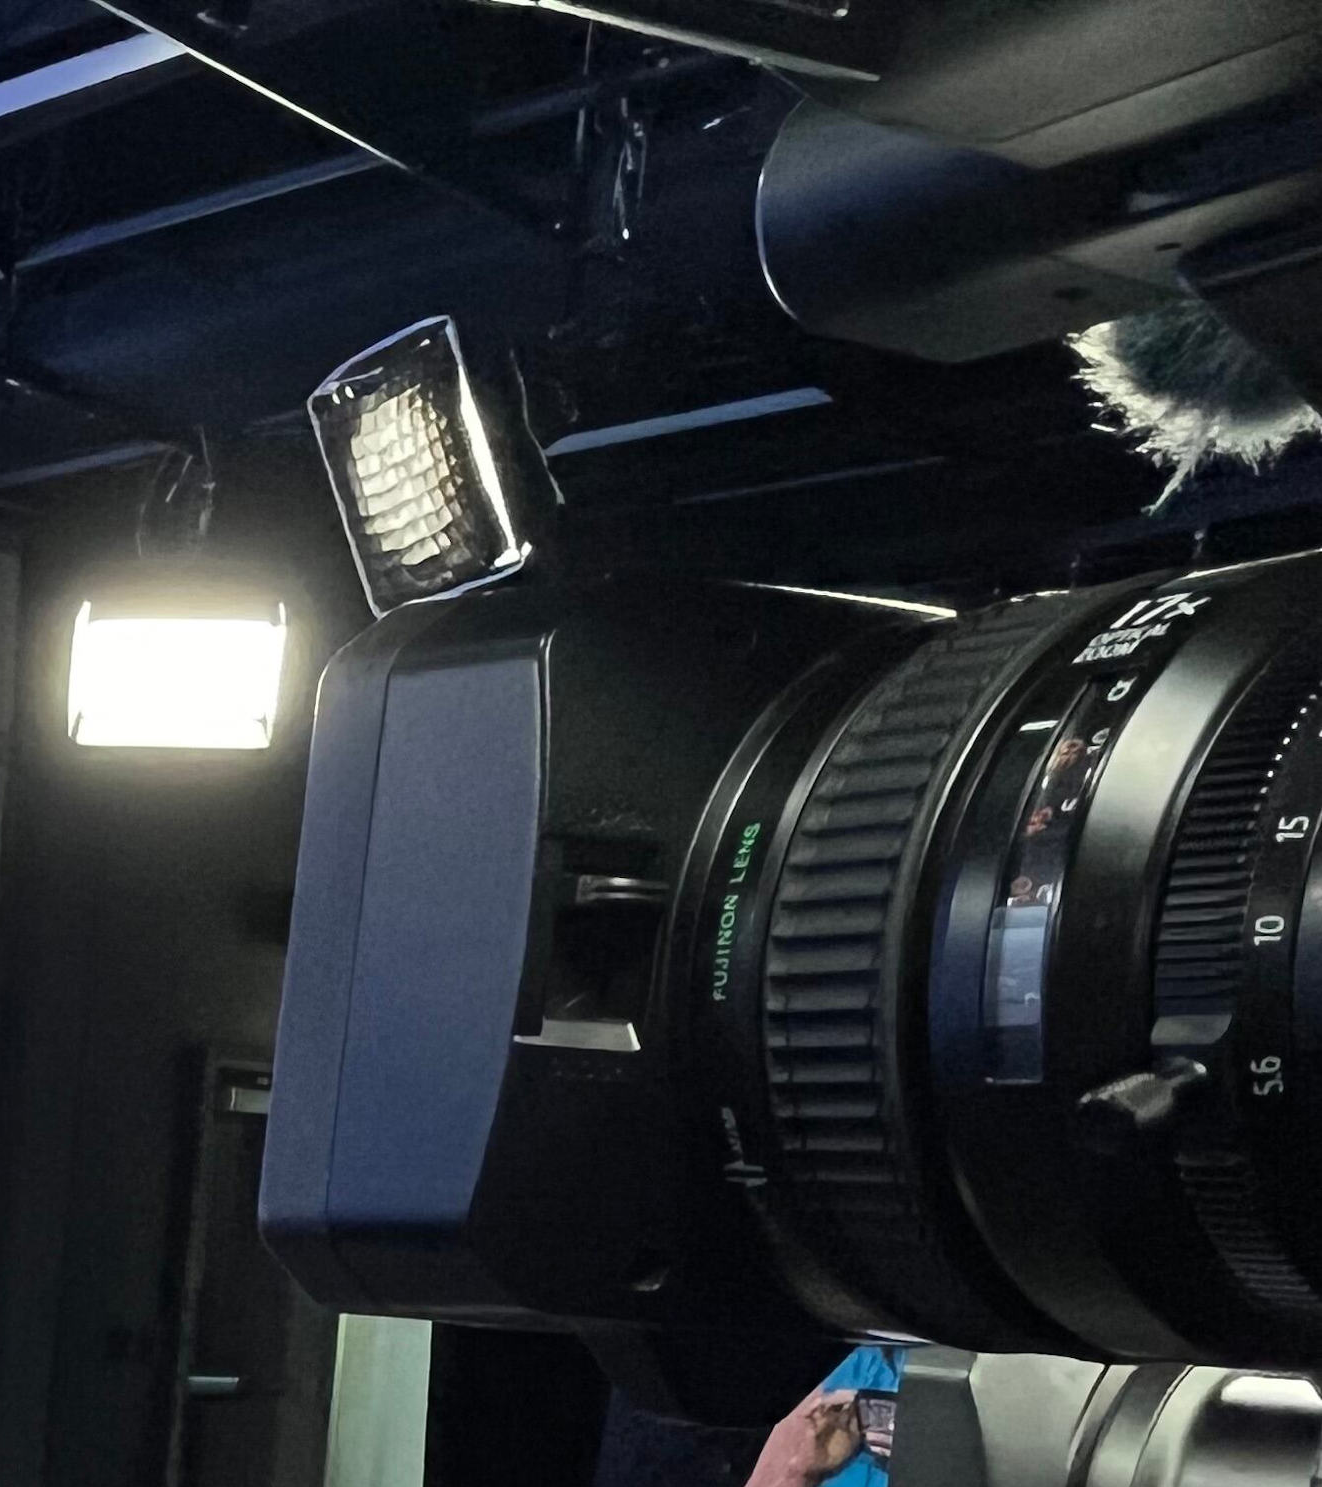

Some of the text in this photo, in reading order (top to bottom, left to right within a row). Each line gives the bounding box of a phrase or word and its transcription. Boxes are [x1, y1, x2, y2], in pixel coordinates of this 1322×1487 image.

[1274, 813, 1311, 845] 15
[712, 893, 740, 1002] FUJINON
[1252, 914, 1286, 948] 10
